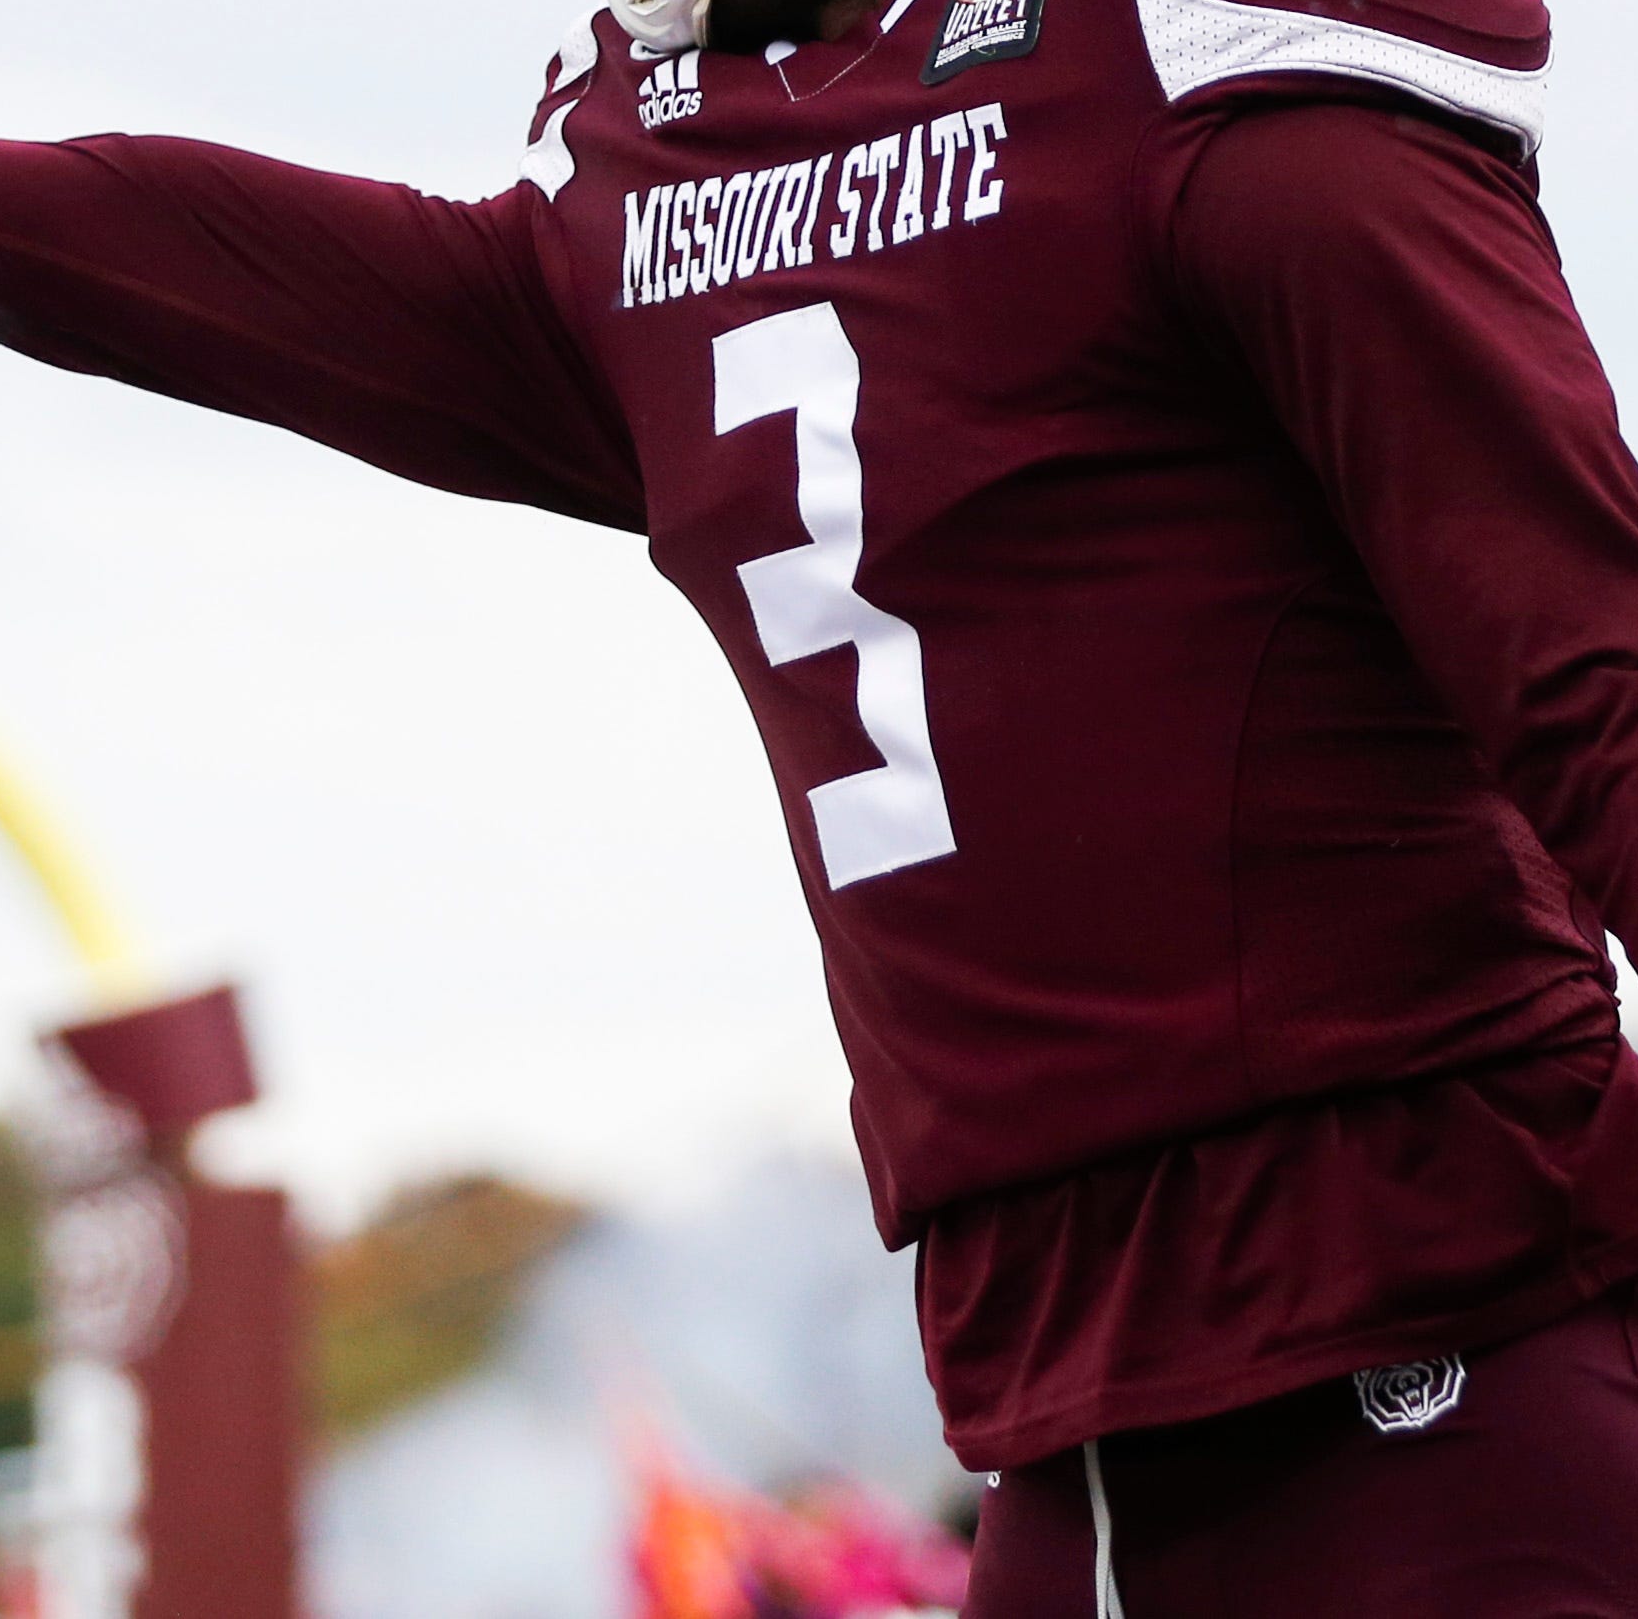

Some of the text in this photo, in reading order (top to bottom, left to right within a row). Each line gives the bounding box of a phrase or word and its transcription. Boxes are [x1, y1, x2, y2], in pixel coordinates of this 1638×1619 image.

[621, 102, 1008, 308] MISSOURI STATE
[637, 87, 703, 130] adidas
[712, 301, 957, 891] 3
